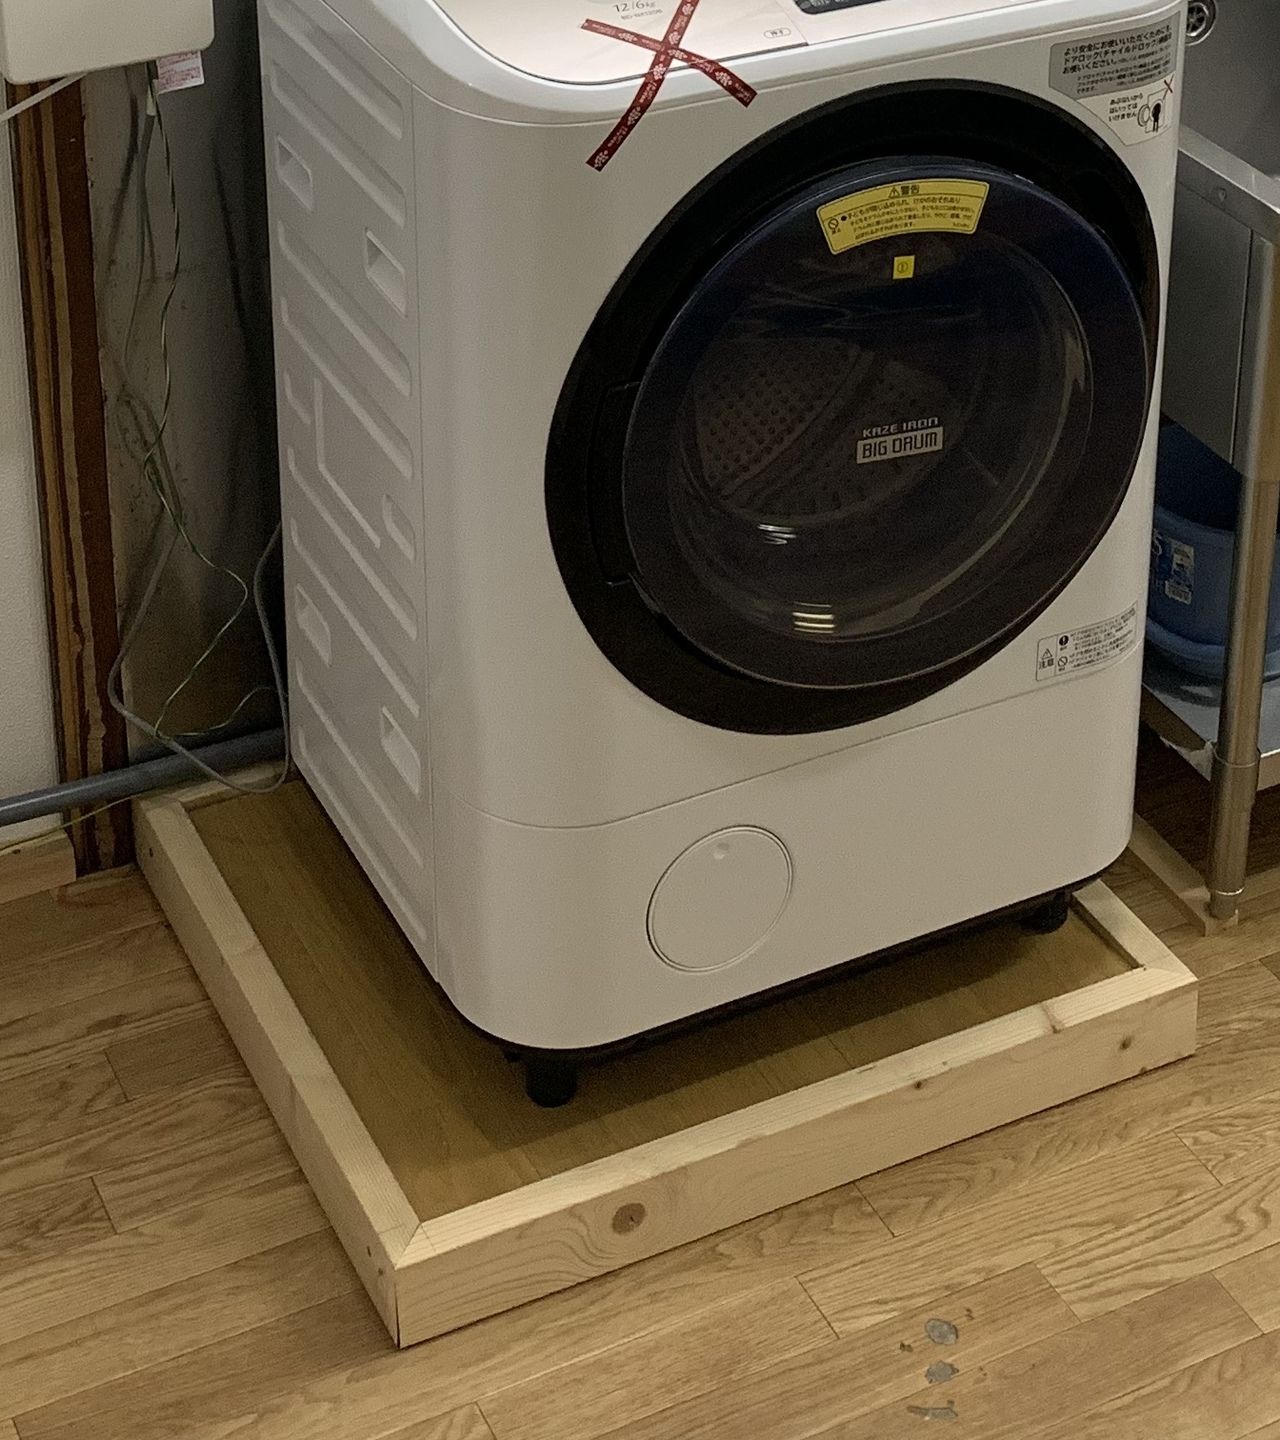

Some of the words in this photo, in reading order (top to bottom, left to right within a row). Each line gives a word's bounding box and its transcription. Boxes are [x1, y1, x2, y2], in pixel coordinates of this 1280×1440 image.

[1108, 112, 1137, 122] いけません
[901, 184, 920, 195] 警告
[863, 422, 898, 437] KAZE
[902, 417, 939, 432] IRON
[862, 439, 887, 460] BIG
[892, 431, 939, 454] DRUM
